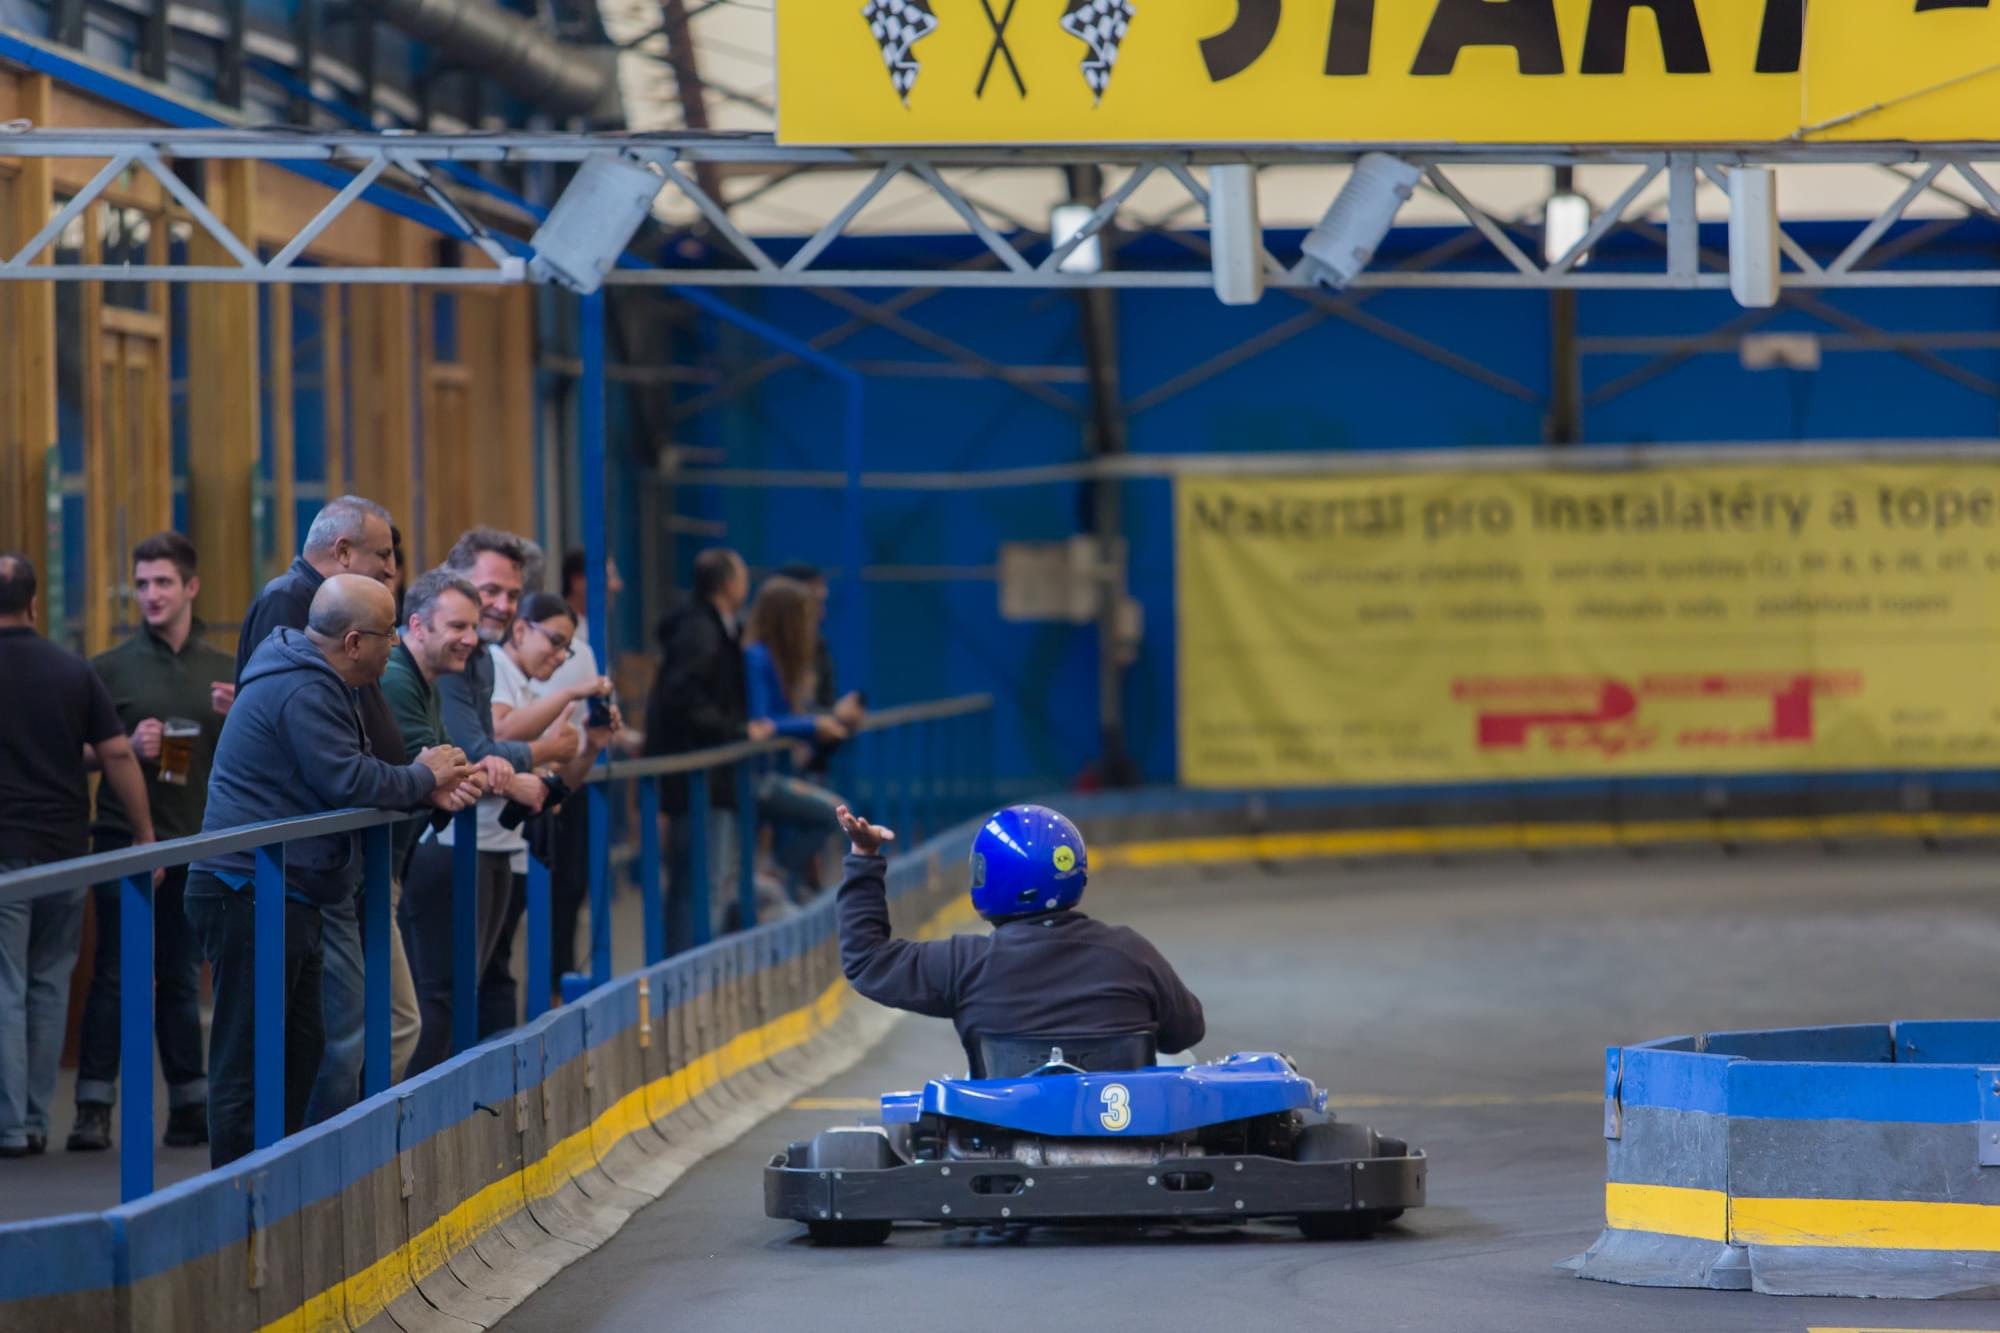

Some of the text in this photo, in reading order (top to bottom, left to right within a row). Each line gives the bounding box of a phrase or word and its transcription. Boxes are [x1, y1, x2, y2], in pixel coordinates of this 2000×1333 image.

[1424, 494, 1514, 543] pro
[1531, 484, 1811, 538] instalatéry
[1829, 490, 1859, 532] a
[1100, 1083, 1132, 1132] 3
